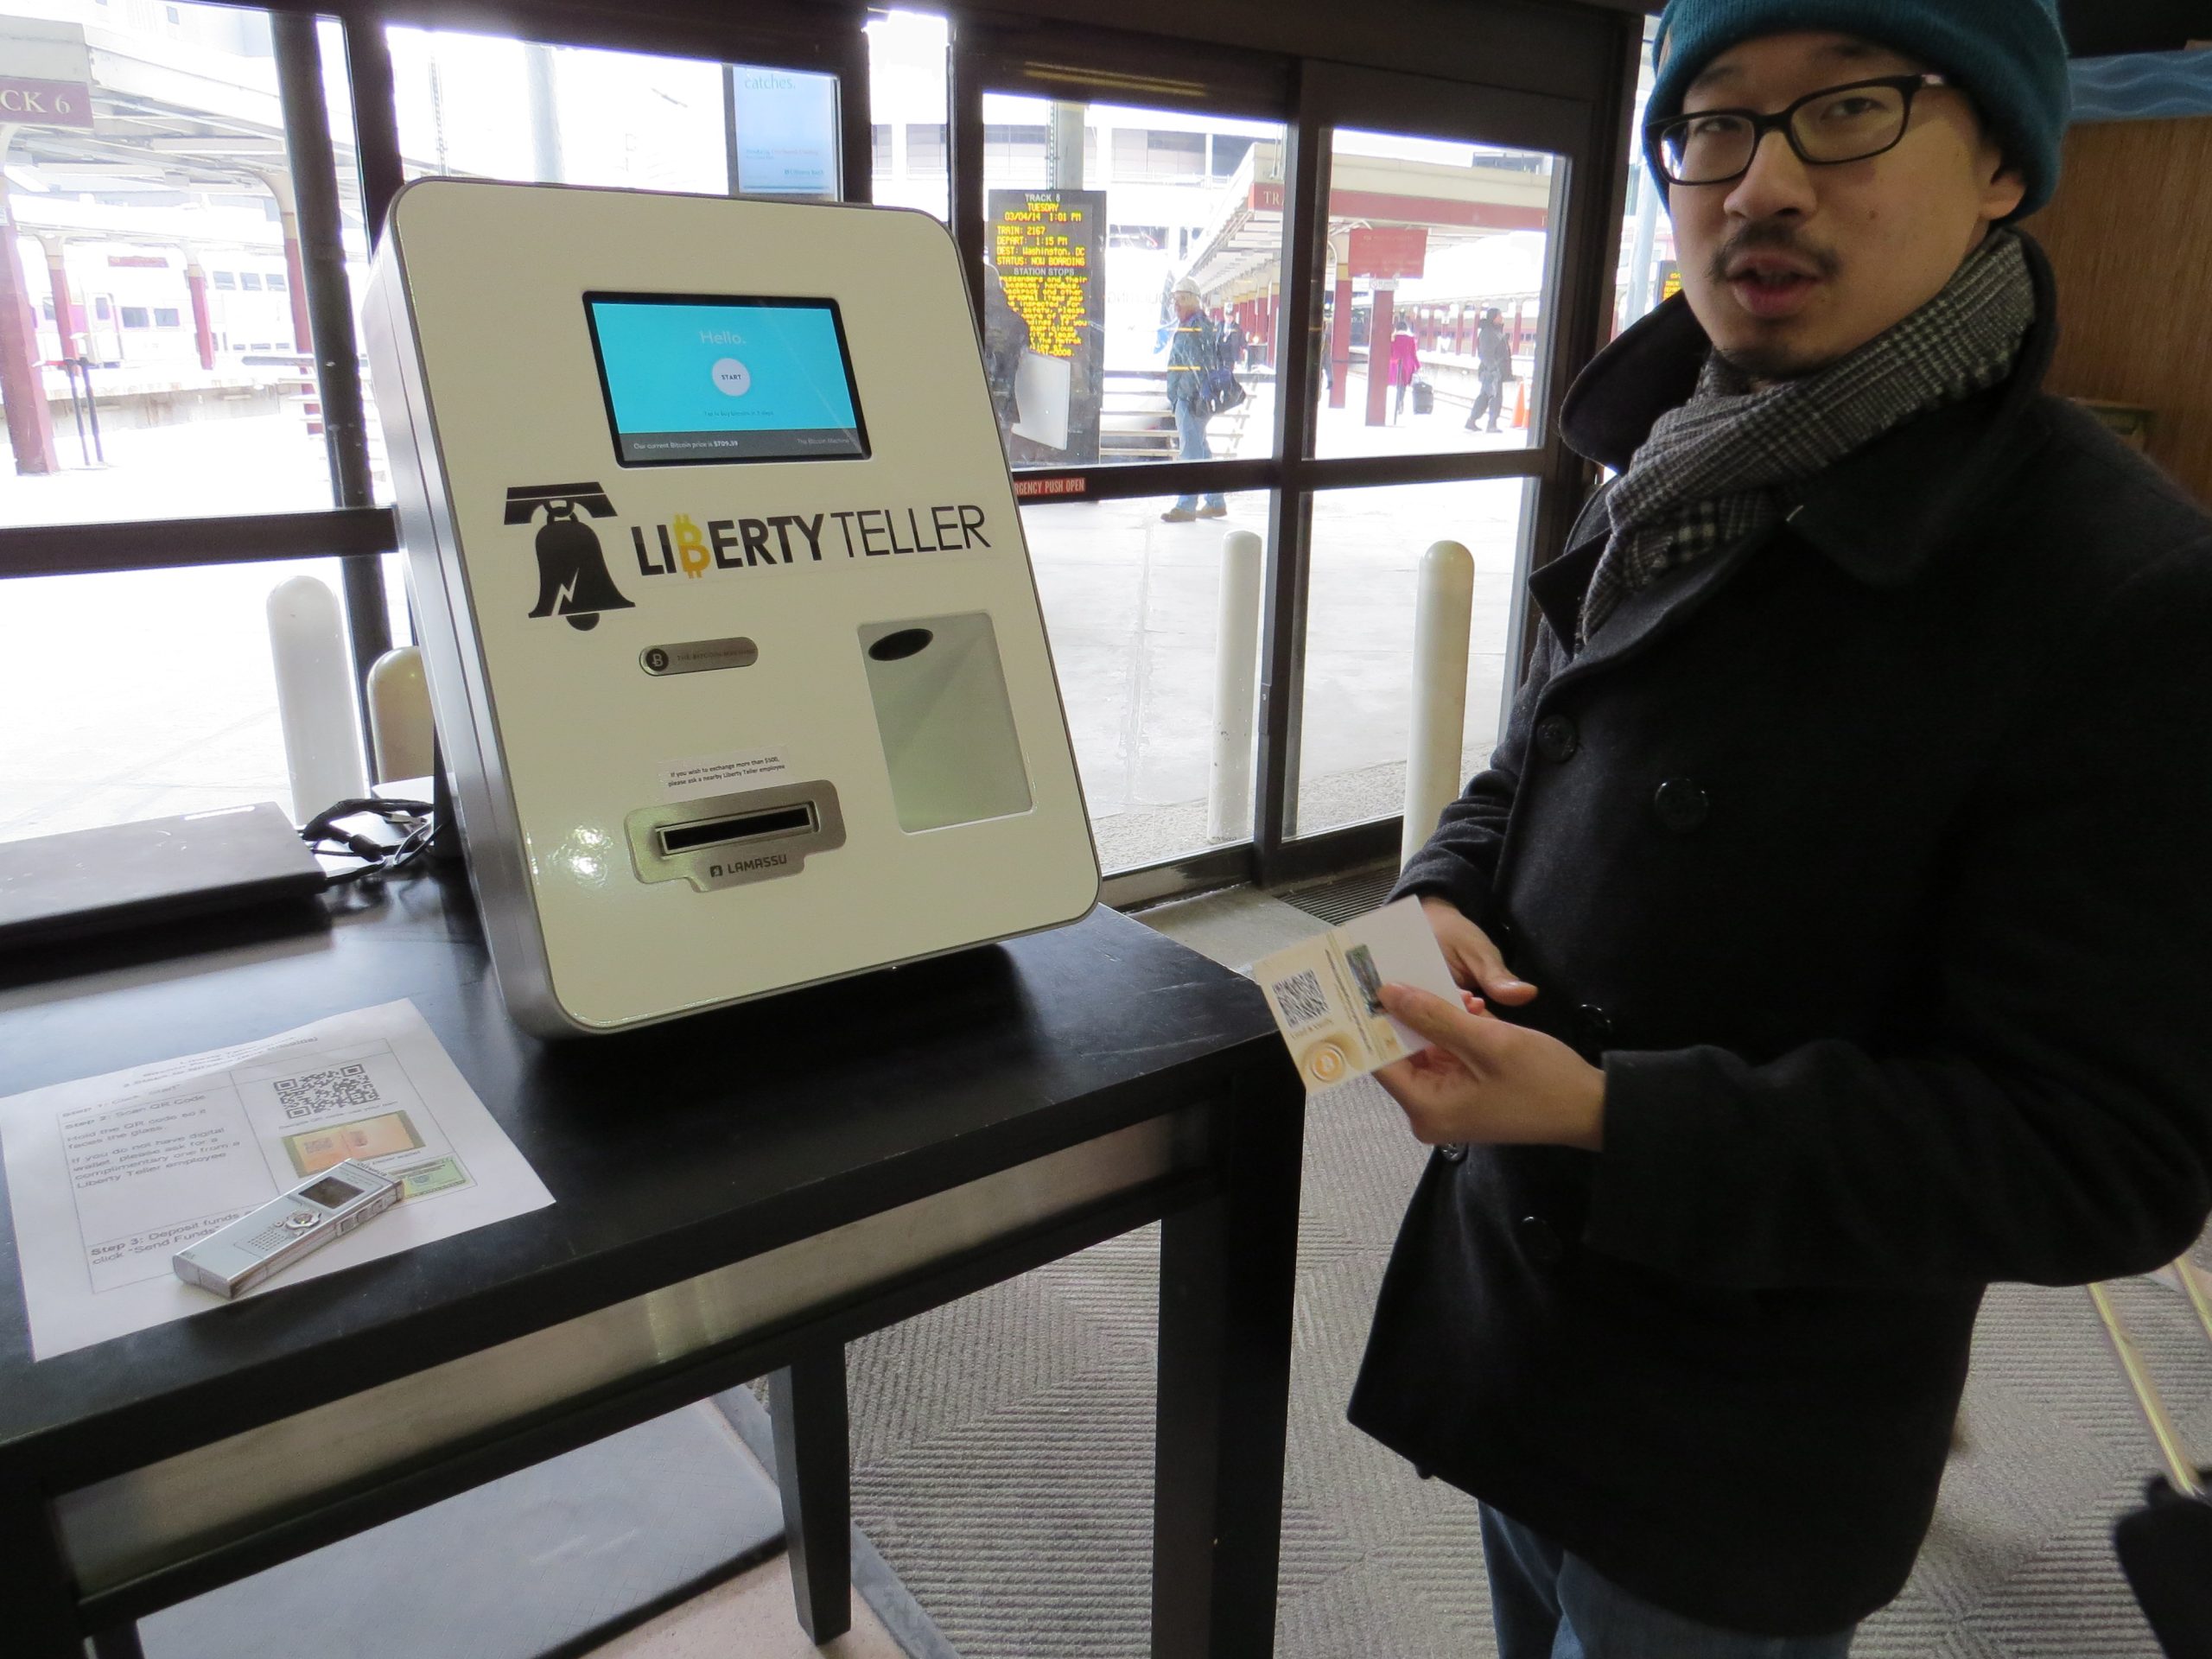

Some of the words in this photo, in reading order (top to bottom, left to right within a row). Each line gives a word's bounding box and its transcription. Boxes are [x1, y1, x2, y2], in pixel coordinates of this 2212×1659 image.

[745, 74, 796, 90] catches.
[0, 89, 48, 113] CK
[54, 93, 71, 114] 6
[1027, 202, 1059, 213] TUESDAY
[1004, 212, 1041, 221] 03/04/14
[1050, 213, 1067, 222] 1:01
[1071, 213, 1082, 221] PM
[997, 226, 1023, 235] TRAIN:
[1027, 226, 1046, 235] 2167
[996, 236, 1027, 245] DEPART:
[1036, 237, 1054, 245] 1:15
[1057, 237, 1068, 245] PM
[996, 246, 1019, 256] DEST:
[1075, 247, 1085, 257] DC
[996, 257, 1027, 265] STATUS:
[1031, 257, 1046, 265] NOW
[1048, 257, 1085, 266] BOARDING
[1014, 267, 1046, 276] STATION
[698, 330, 747, 345] Hello.
[692, 441, 708, 449] price
[1014, 481, 1042, 495] RGENCY
[1045, 480, 1064, 494] PUSH
[1066, 478, 1084, 493] OPEN
[830, 504, 993, 558] TELLER
[668, 779, 687, 787] please
[722, 770, 742, 779] Liberty
[759, 764, 785, 773] employee
[709, 763, 735, 772] exchange
[728, 854, 787, 874] LAMASSU
[149, 1101, 170, 1110] QR
[174, 1094, 207, 1106] Code
[100, 1126, 120, 1135] the
[148, 1114, 177, 1124] code
[68, 1138, 104, 1150] faces
[82, 1151, 109, 1162] you
[131, 1141, 151, 1150] not
[156, 1135, 186, 1146] have
[188, 1127, 225, 1140] digital
[118, 1148, 161, 1162] please
[164, 1143, 186, 1153] ask
[189, 1139, 206, 1147] for
[174, 1150, 196, 1159] one
[200, 1142, 229, 1153] from
[77, 1173, 122, 1189] Liberty
[126, 1164, 161, 1177] Teller
[165, 1152, 227, 1169] employee
[91, 1241, 125, 1256] Step
[130, 1236, 143, 1246] 3:
[149, 1223, 199, 1241] Deposit
[203, 1213, 240, 1227] funds
[92, 1252, 125, 1265] click
